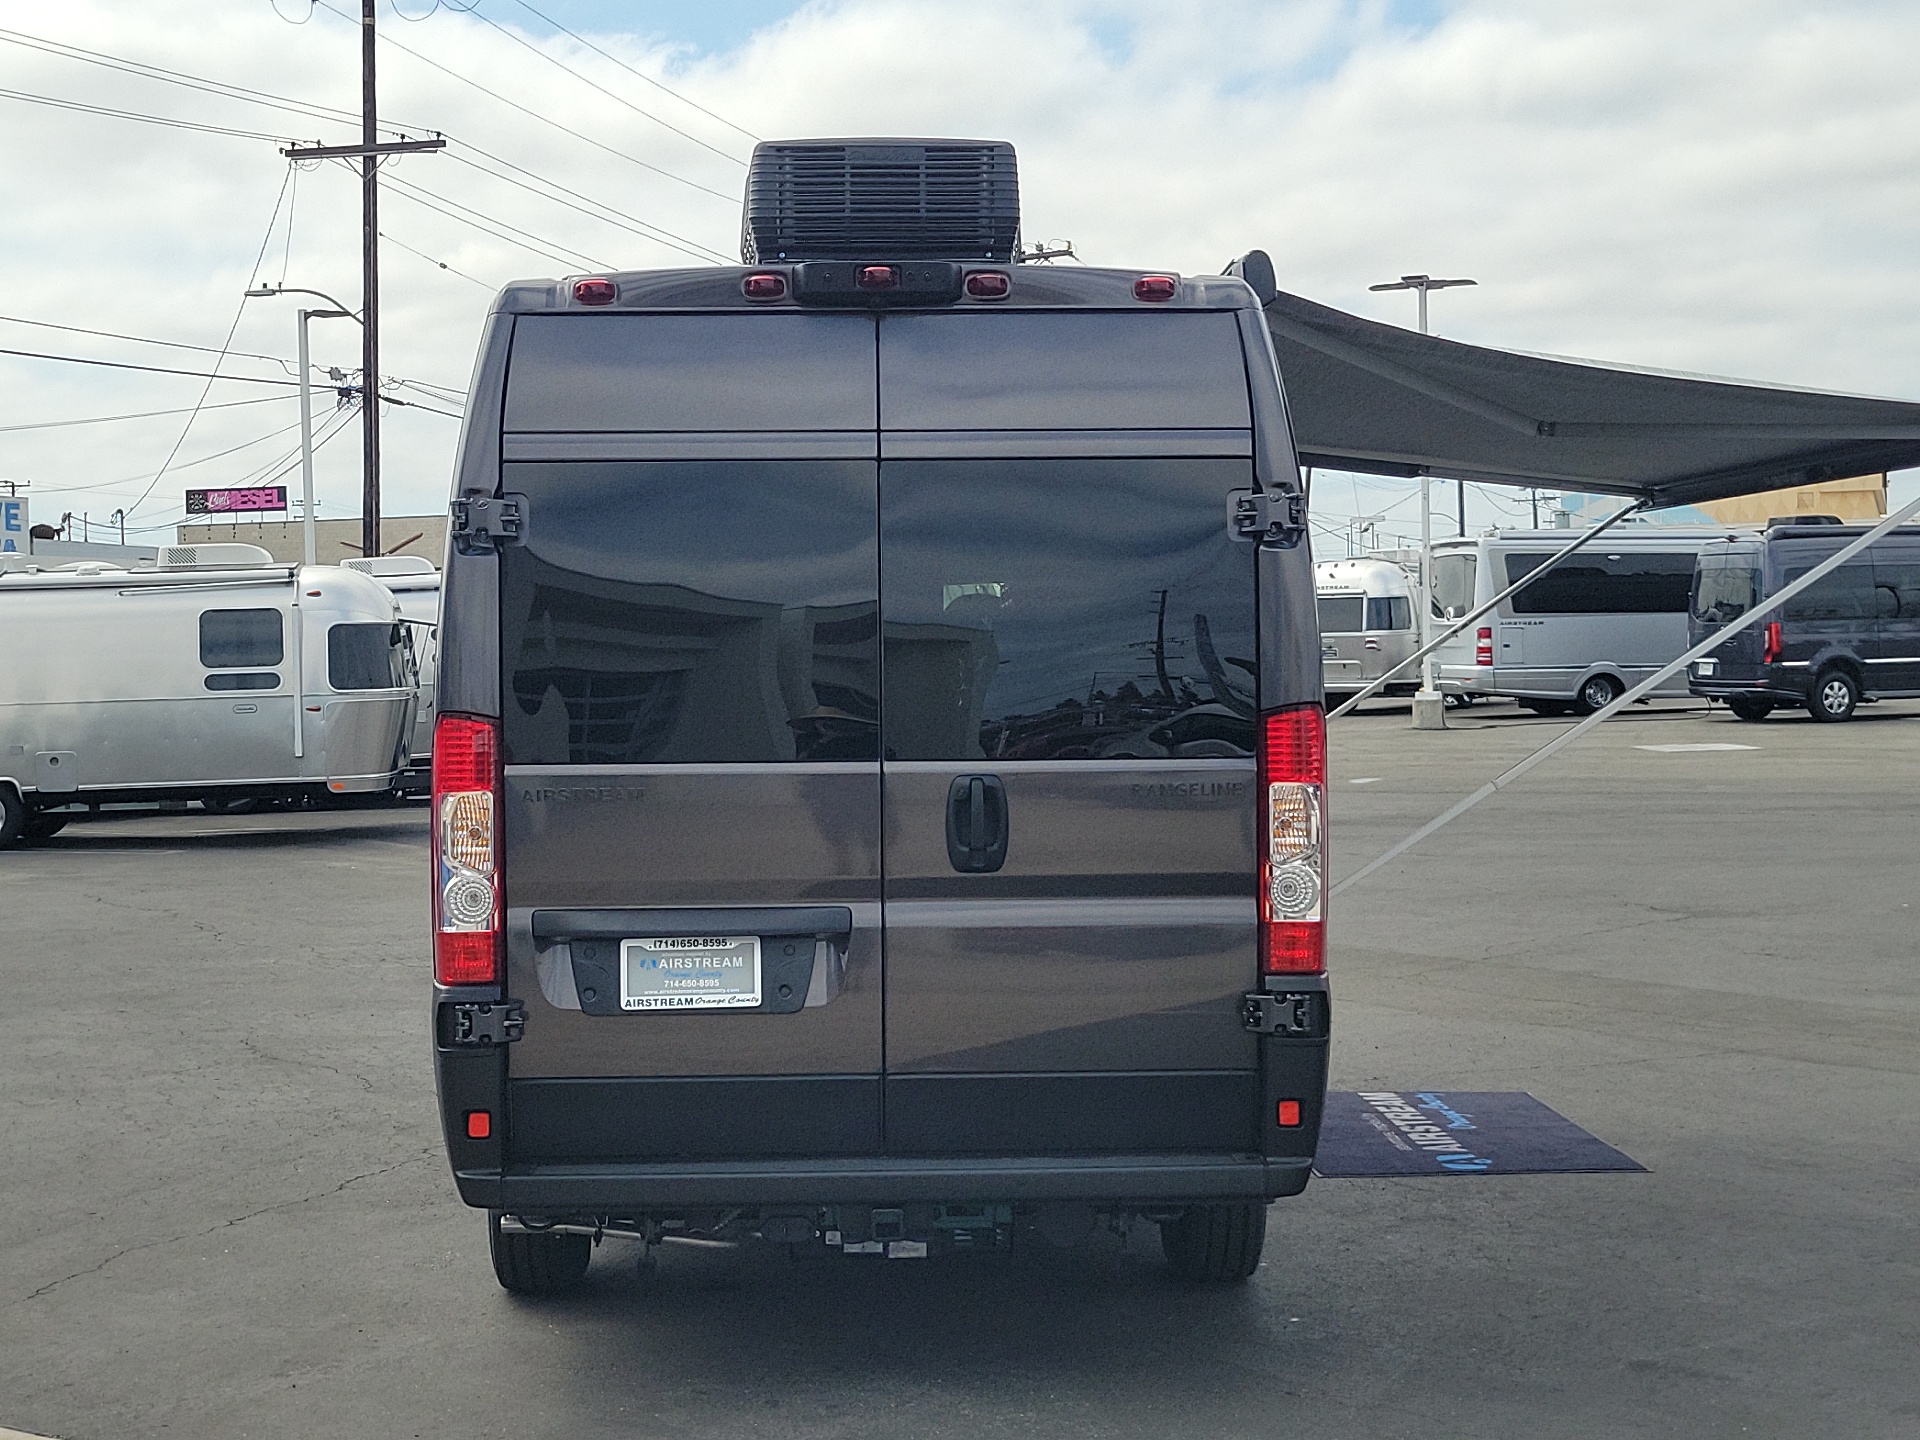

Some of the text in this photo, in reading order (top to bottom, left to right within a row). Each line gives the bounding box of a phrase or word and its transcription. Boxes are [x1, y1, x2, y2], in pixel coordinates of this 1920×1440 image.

[653, 938, 728, 949] (714)650-8595
[658, 956, 743, 969] AIRSTREAM
[664, 979, 720, 988] 714-650-8595
[624, 995, 759, 1008] AIRSTREAM Orange County
[1356, 1092, 1470, 1152] AIRSTREAM
